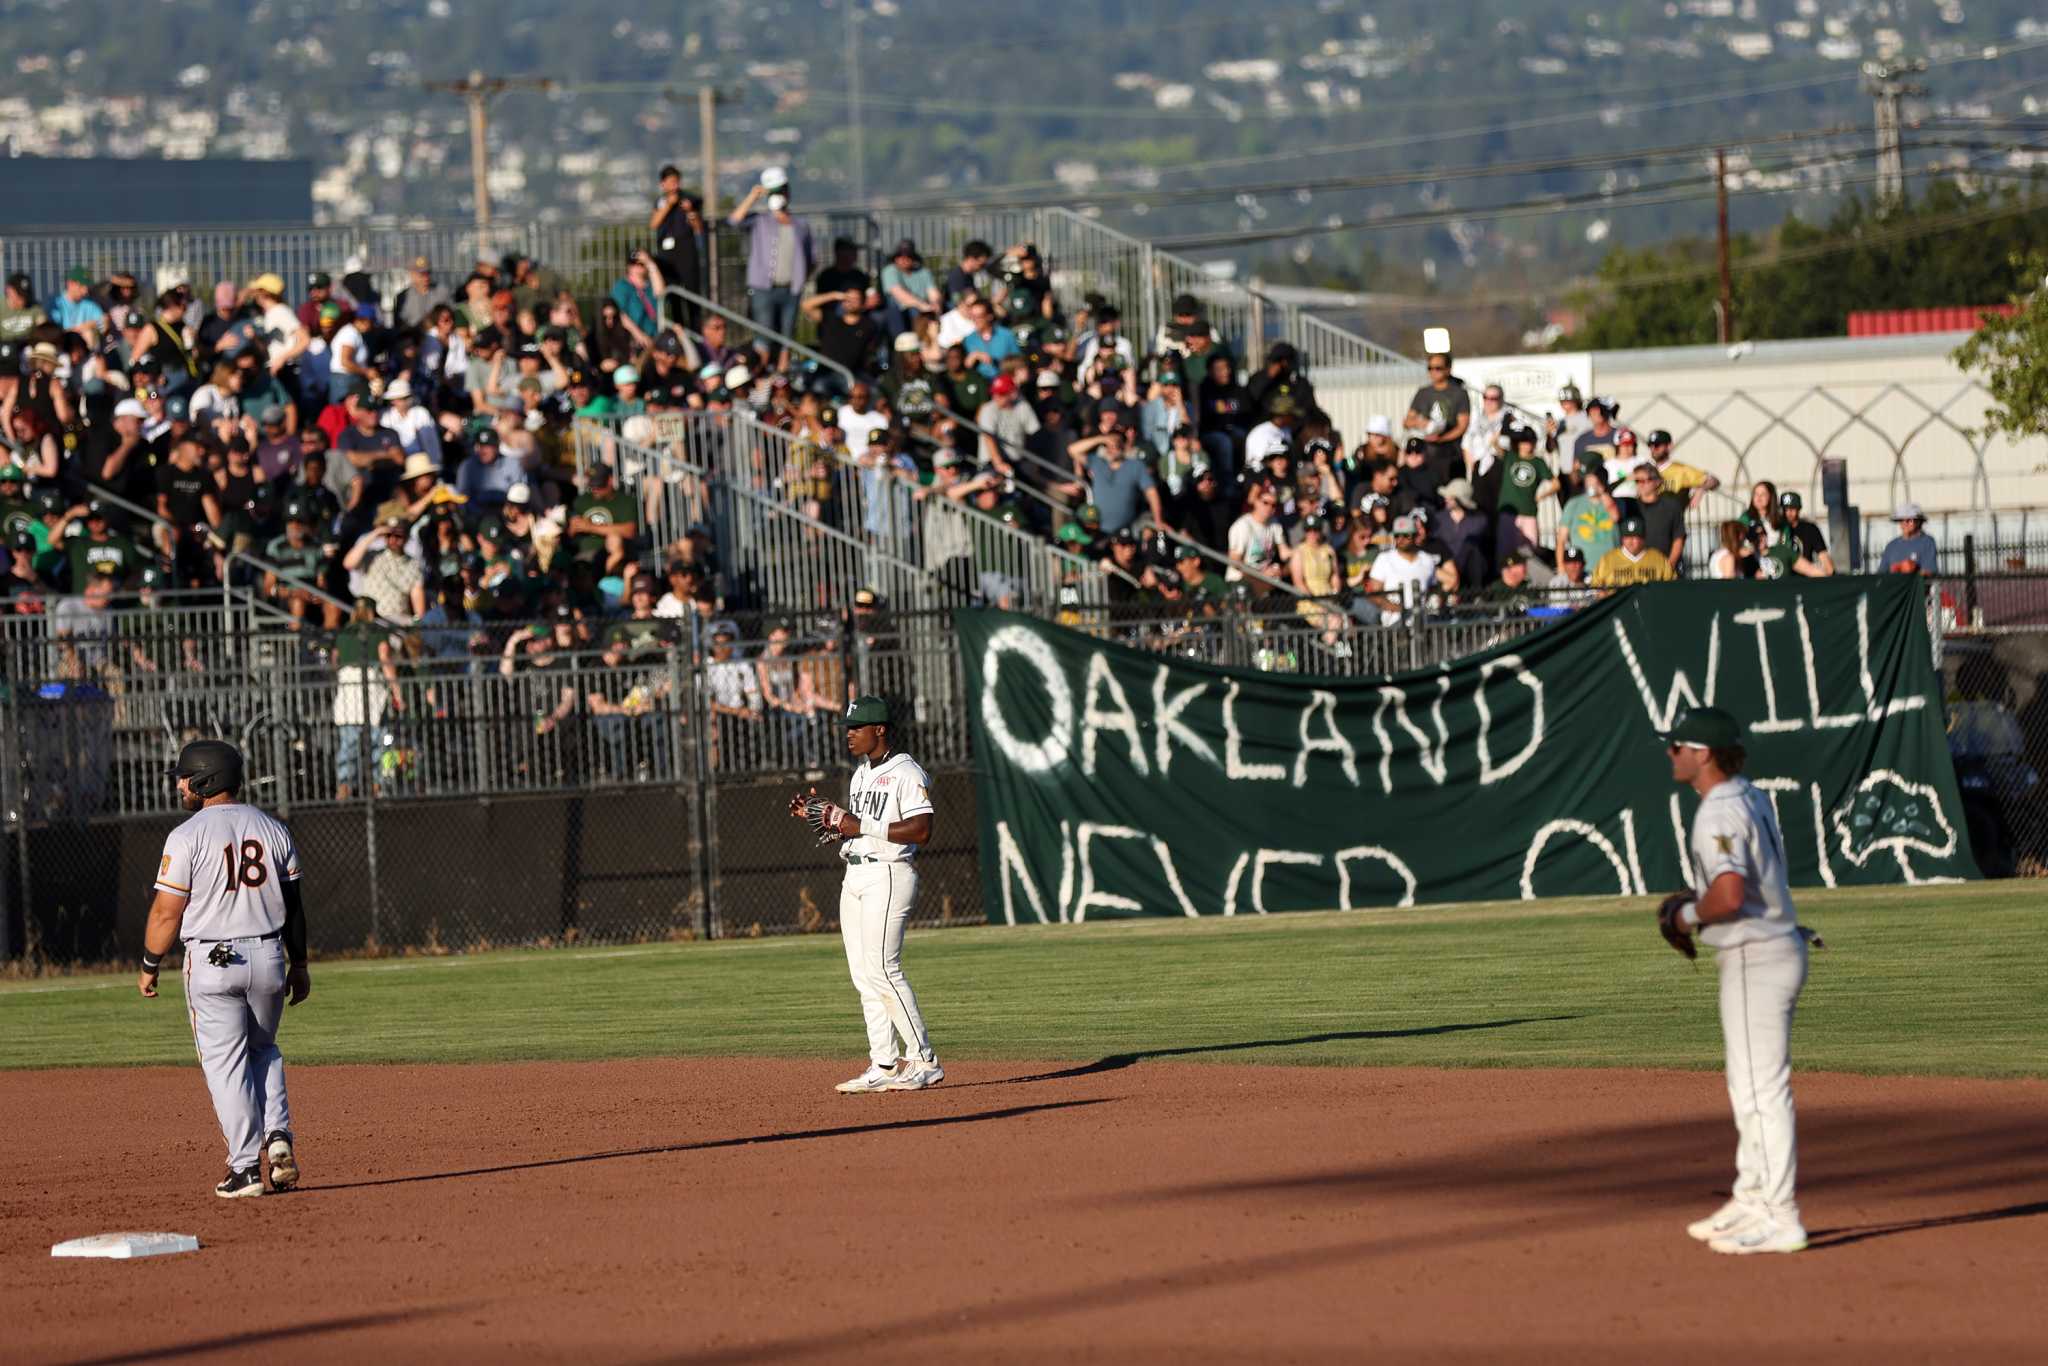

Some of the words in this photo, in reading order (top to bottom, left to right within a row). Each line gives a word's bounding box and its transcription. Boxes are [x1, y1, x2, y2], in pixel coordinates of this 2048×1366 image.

[981, 624, 1545, 794] OAKLAND
[1613, 595, 1927, 734] WILL
[224, 838, 268, 892] 18
